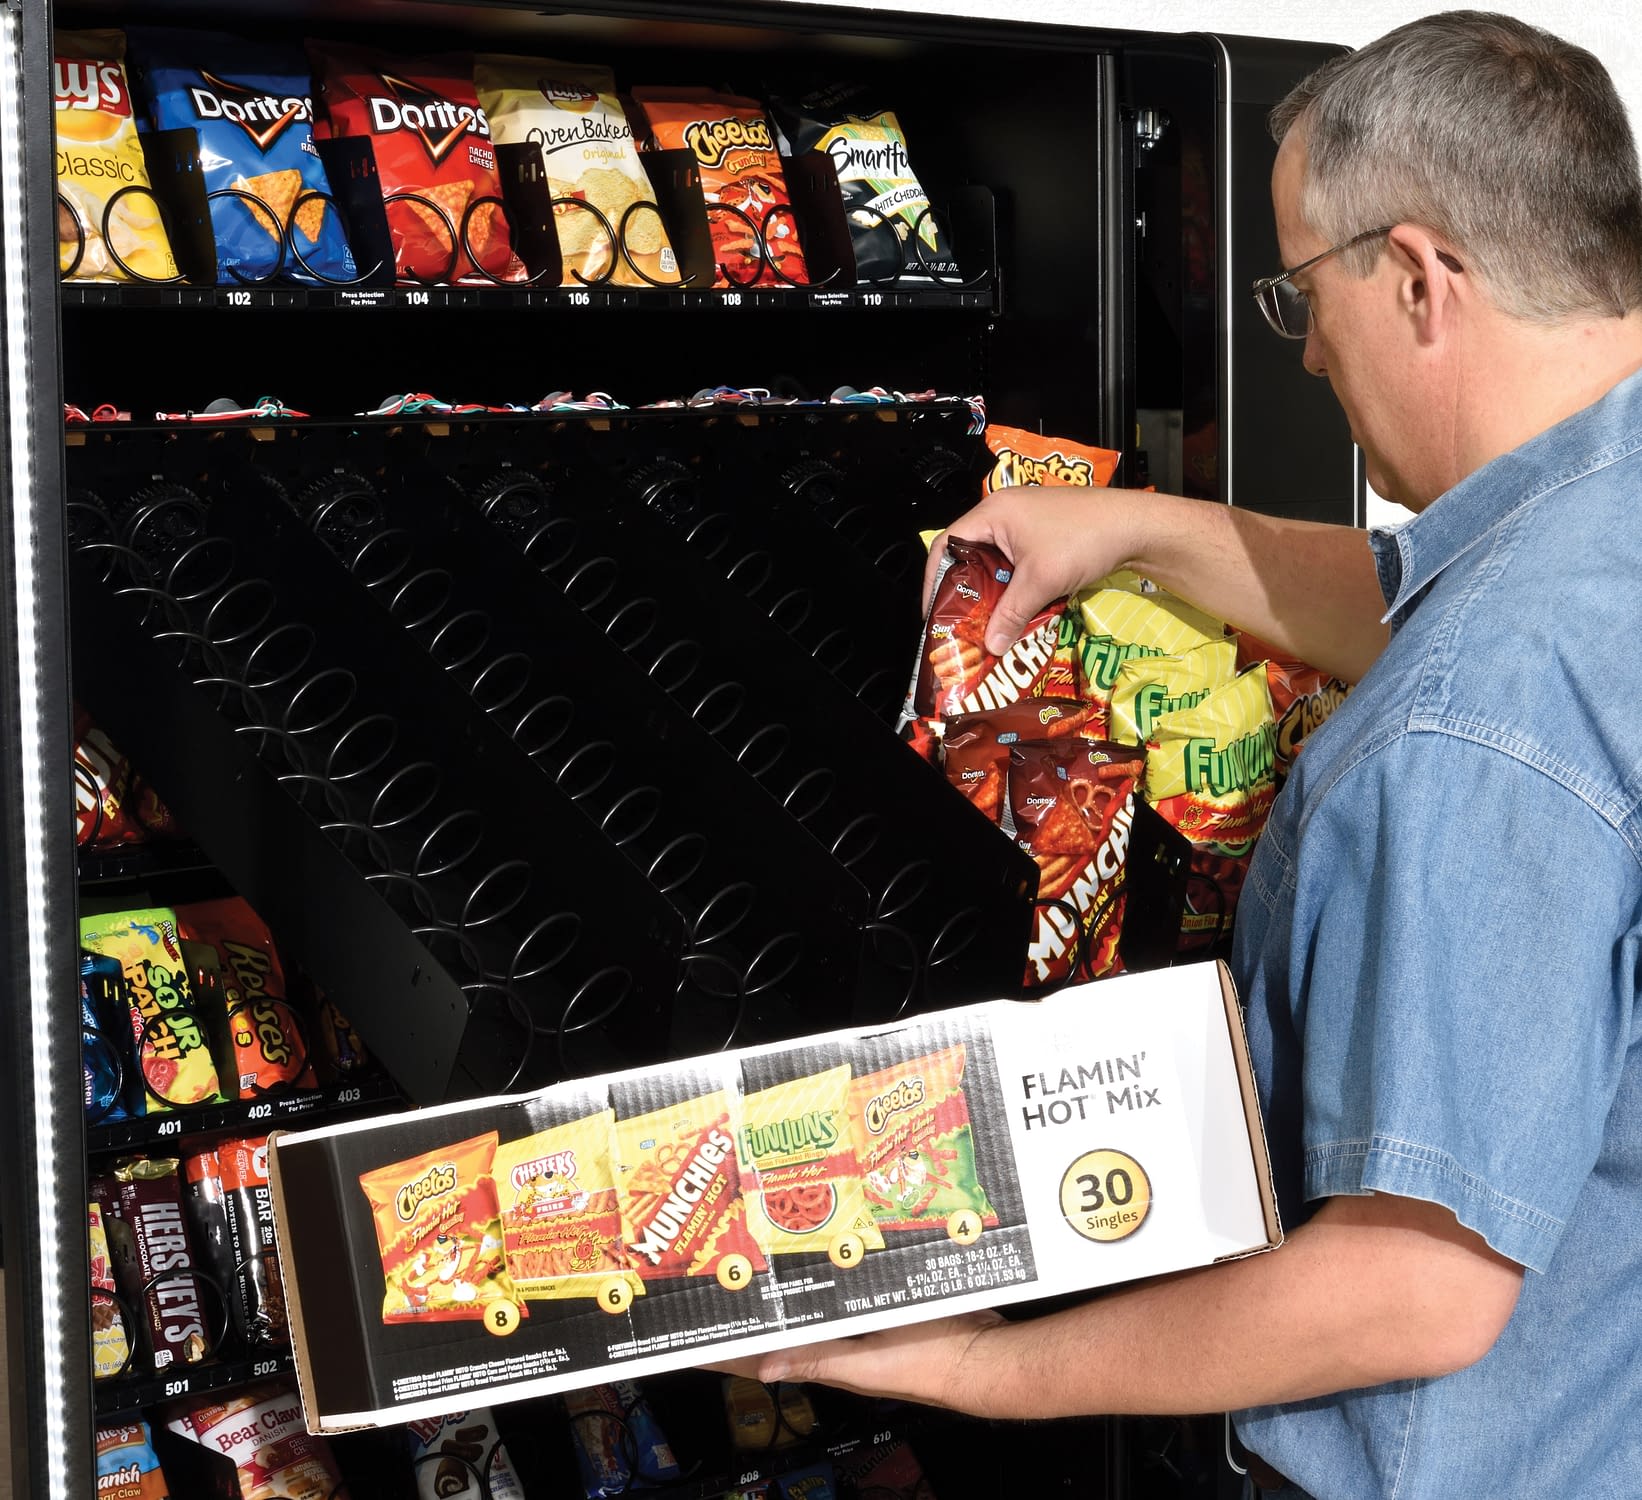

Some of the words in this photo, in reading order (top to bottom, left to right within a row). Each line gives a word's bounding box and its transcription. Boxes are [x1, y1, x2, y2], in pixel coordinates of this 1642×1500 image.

[370, 97, 491, 136] Doritos
[686, 117, 772, 166] Cheetos
[468, 145, 493, 161] NACHO
[469, 154, 495, 170] CHEESE
[724, 152, 767, 176] Crunchy
[893, 186, 927, 204] CHEDDA
[226, 292, 252, 306] 102
[405, 292, 429, 306] 104
[568, 292, 590, 306] 106
[721, 293, 742, 307] 108
[862, 293, 882, 306] 110
[956, 583, 980, 600] Doritos
[961, 768, 986, 782] Doritos
[1022, 1051, 1147, 1100] FLAMIN'
[338, 1088, 362, 1104] 403
[248, 1103, 273, 1121] 402
[864, 1078, 924, 1135] Cheetos
[1022, 1095, 1090, 1132] HOT
[1105, 1083, 1163, 1115] Mix
[157, 1119, 183, 1137] 401
[737, 1110, 839, 1166] FUNYUNS
[397, 1163, 457, 1222] Cheetos
[1075, 1167, 1135, 1214] 30
[255, 1187, 272, 1222] BAR
[535, 1201, 565, 1214] FRIES
[226, 1194, 238, 1235] PROTEIN
[232, 1234, 240, 1249] TO
[673, 1203, 708, 1256] FLAMIN'
[704, 1173, 729, 1207] HOT
[1086, 1211, 1139, 1231] Singles
[133, 1215, 144, 1234] MILK
[956, 1220, 970, 1238] 4
[137, 1233, 152, 1278] CHOCOLATE
[838, 1243, 852, 1260] 6
[925, 1258, 937, 1271] 30
[937, 1253, 965, 1270] BAGS:
[965, 1249, 985, 1264] 18-2
[986, 1246, 1002, 1260] OZ.
[727, 1265, 742, 1282] 6
[931, 1270, 948, 1285] OZ.
[992, 1258, 1008, 1271] OZ.
[1008, 1254, 1024, 1268] EA.
[607, 1287, 621, 1305] 6
[844, 1295, 874, 1313] TOTAL
[873, 1292, 892, 1308] NET
[891, 1289, 911, 1304] WT.
[911, 1286, 923, 1300] 54
[923, 1284, 940, 1298] OZ.
[940, 1281, 950, 1297] (3
[950, 1278, 967, 1293] LB.
[967, 1276, 975, 1289] 6
[994, 1268, 1015, 1284] 1.53
[1015, 1267, 1027, 1282] kg
[494, 1310, 508, 1328] 8
[253, 1359, 278, 1377] 502
[165, 1379, 190, 1397] 501
[215, 1422, 261, 1453] Bear
[260, 1406, 301, 1430] Claw
[251, 1425, 289, 1447] DANISH
[872, 1429, 893, 1446] 610
[97, 1463, 141, 1491] anish
[740, 1470, 760, 1485] 608
[117, 1488, 142, 1499] Claw
